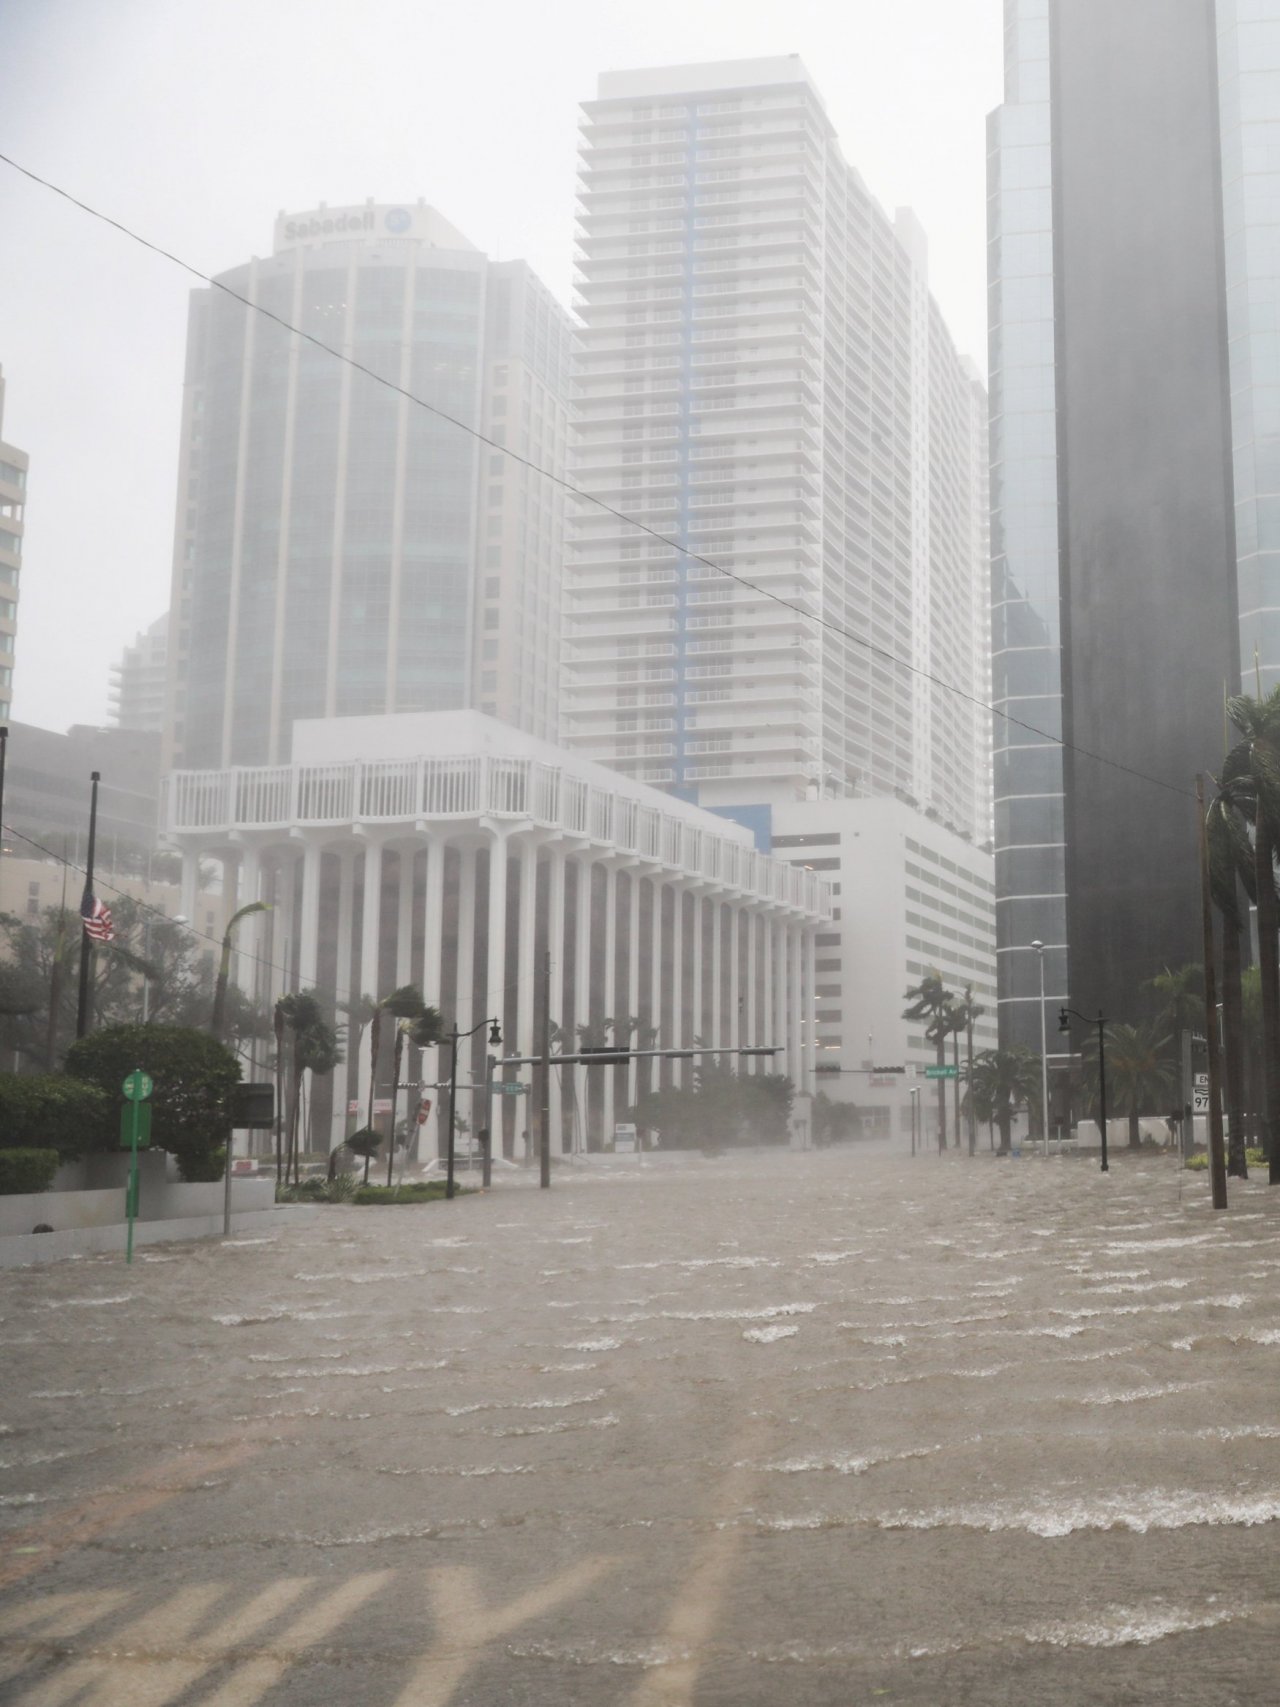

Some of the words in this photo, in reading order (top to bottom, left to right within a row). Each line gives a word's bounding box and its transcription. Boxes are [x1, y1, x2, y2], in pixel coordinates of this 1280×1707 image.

[284, 212, 375, 240] Sabadell
[1200, 1075, 1208, 1083] EN
[1195, 1097, 1208, 1107] 97
